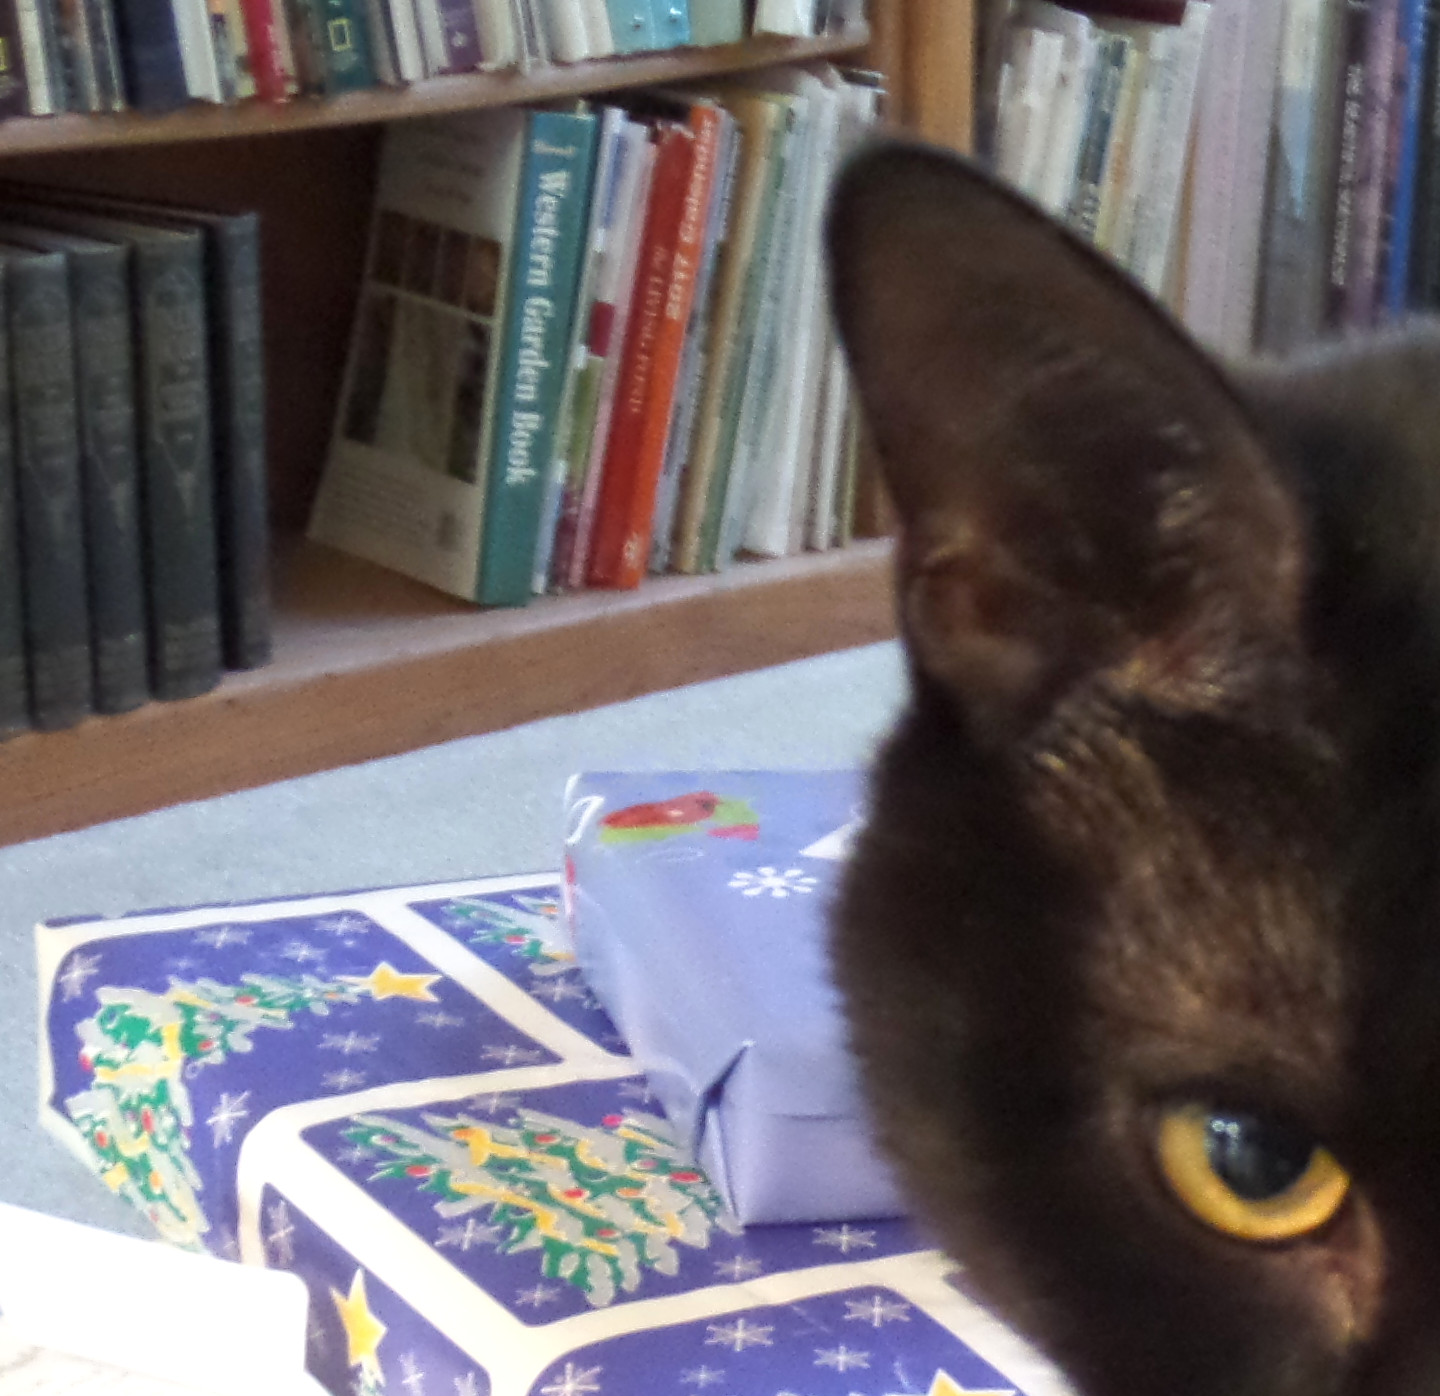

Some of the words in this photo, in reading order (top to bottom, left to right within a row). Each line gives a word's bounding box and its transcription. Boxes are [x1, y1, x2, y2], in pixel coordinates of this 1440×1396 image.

[526, 170, 571, 288] Western
[516, 296, 556, 402] Garden
[504, 411, 544, 488] Book
